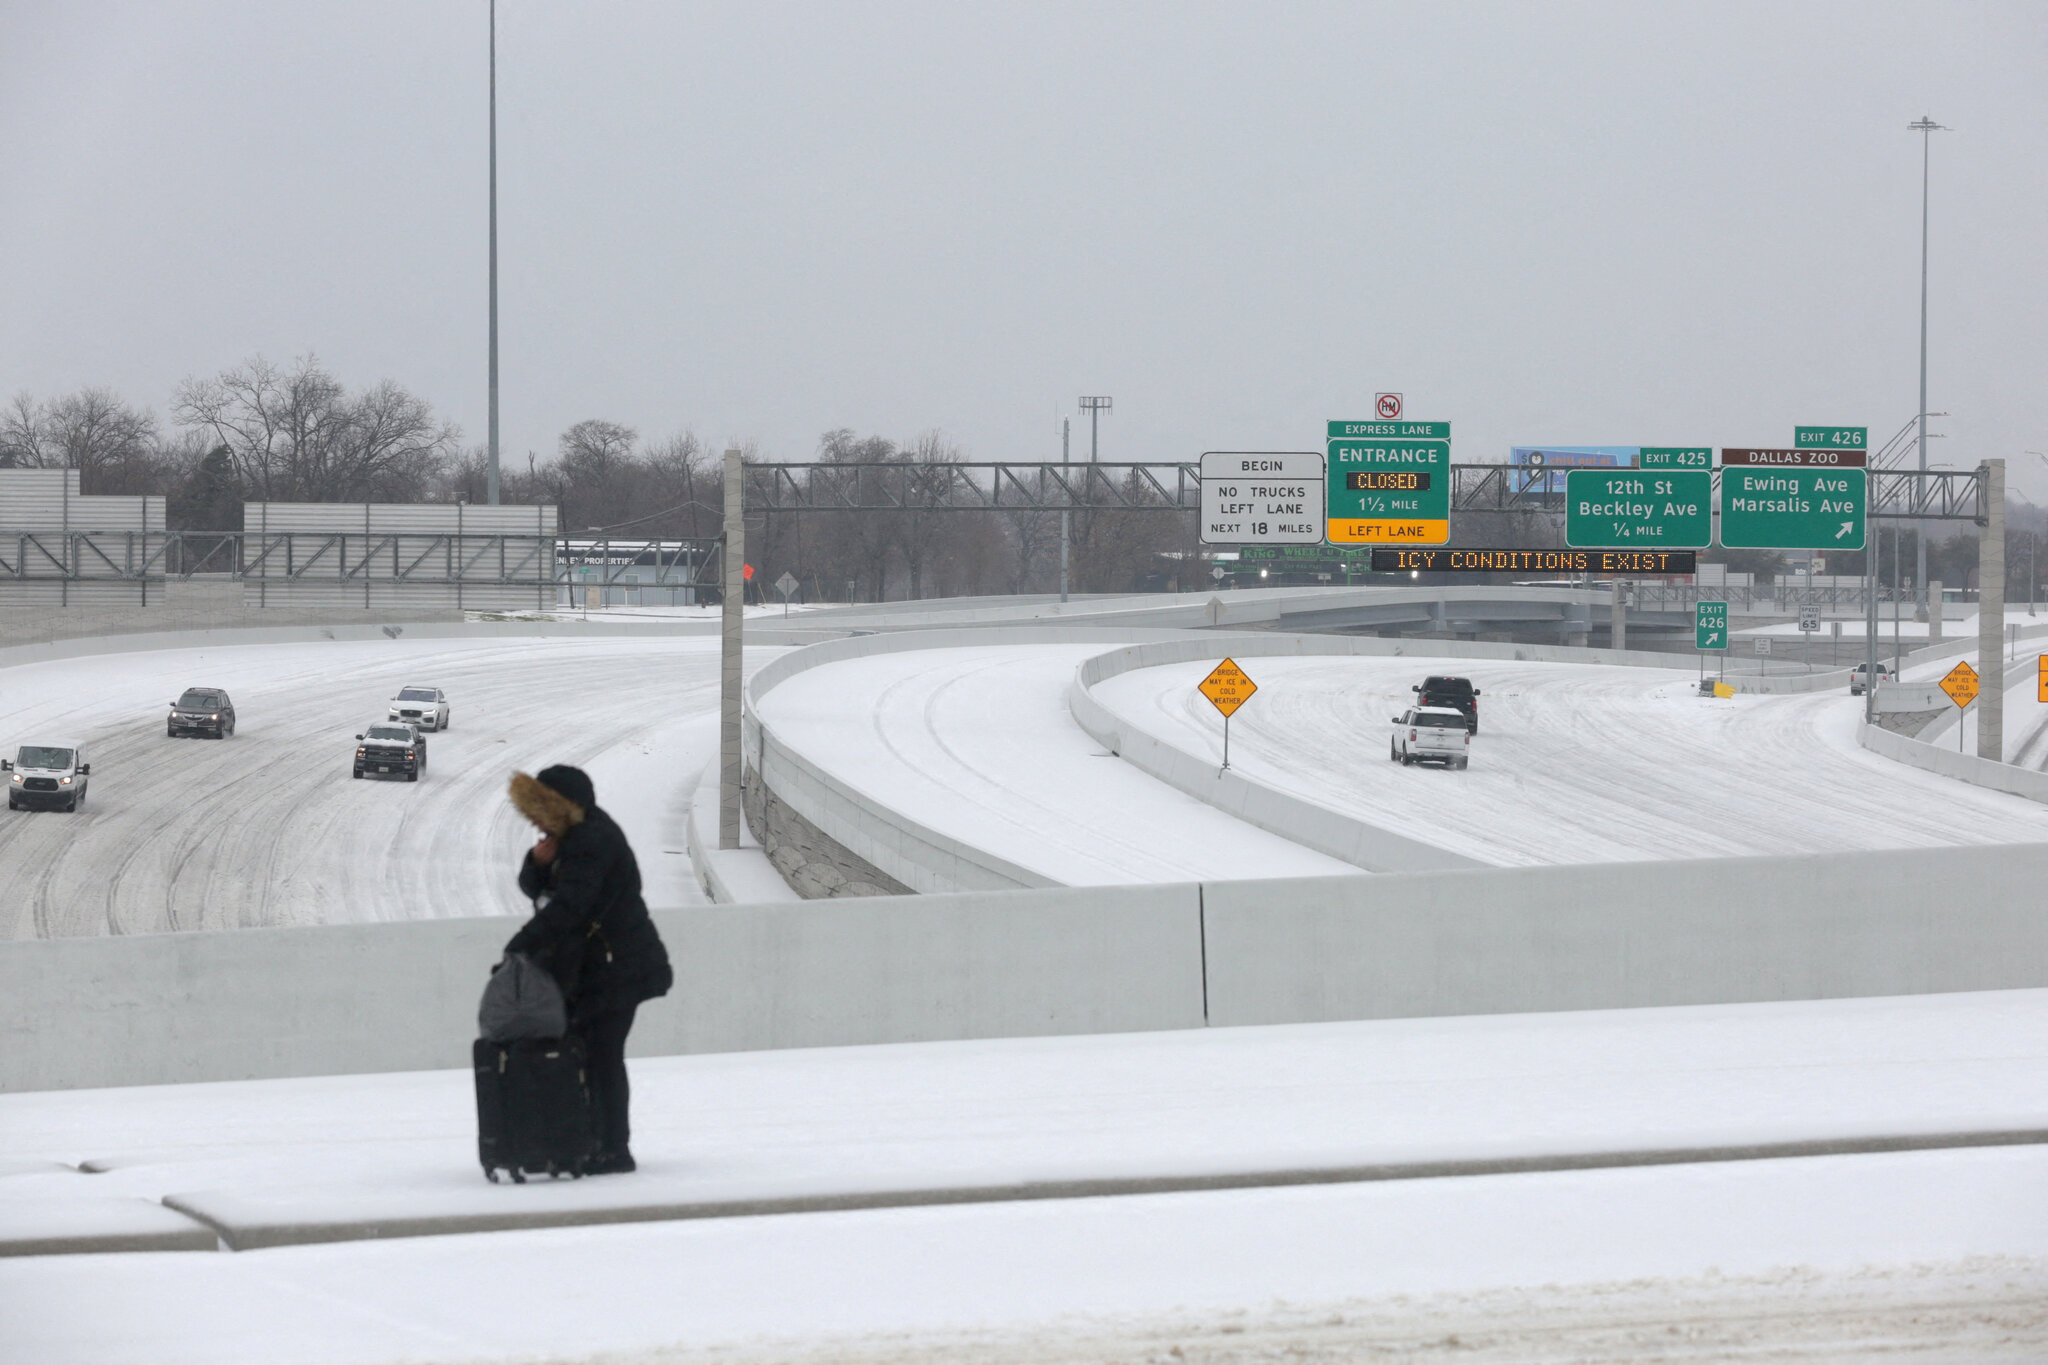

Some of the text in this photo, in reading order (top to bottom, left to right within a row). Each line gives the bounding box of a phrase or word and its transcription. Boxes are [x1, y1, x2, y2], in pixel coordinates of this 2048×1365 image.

[1345, 426, 1431, 434] EXPRESS LANE
[1801, 431, 1861, 445] EXIT 426
[1340, 449, 1437, 462] ENTRANCE
[1550, 456, 1574, 464] chill
[1578, 457, 1598, 465] out
[1646, 452, 1706, 465] EXIT 425
[1749, 452, 1838, 464] DALLAS ZOO
[1242, 461, 1283, 471] BEGIN
[1357, 474, 1417, 489] CLOSED
[1606, 480, 1672, 495] 12th St
[1744, 477, 1848, 495] Ewing Ave
[1219, 487, 1305, 497] NO TRUCKS
[1221, 504, 1303, 514] LEFT LANE
[1392, 500, 1418, 509] MILE
[1580, 502, 1697, 518] Beckley Ave
[1732, 498, 1854, 513] Marsalis Ave
[1212, 523, 1312, 534] NEXT 18 MILES
[1349, 526, 1424, 537] LEFT LANE
[1637, 527, 1662, 536] MILE
[1244, 550, 1275, 558] KING
[1398, 552, 1669, 570] ICY CONDITIONS EXIST
[1699, 605, 1725, 629] EXIT 426
